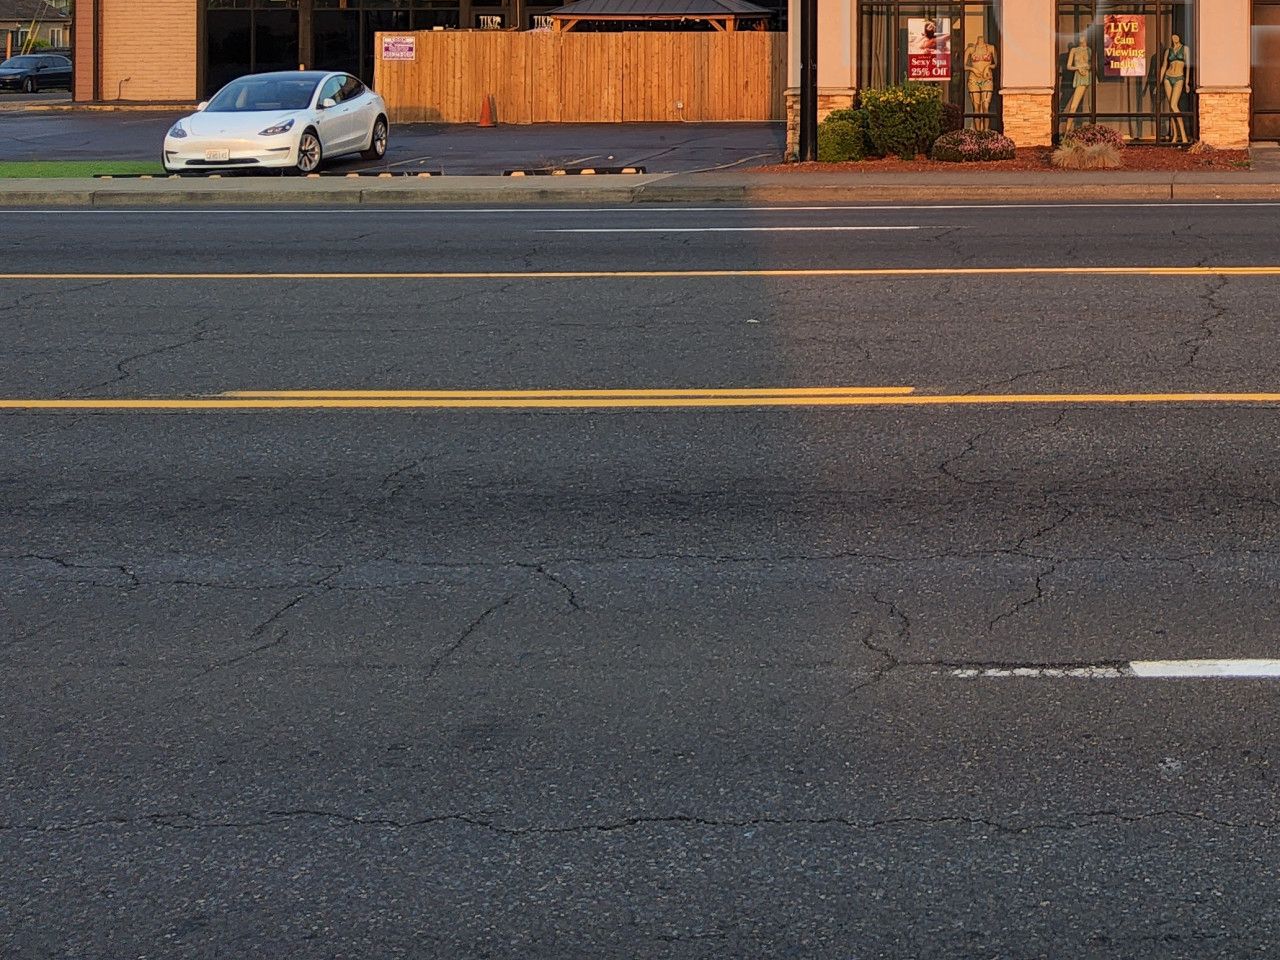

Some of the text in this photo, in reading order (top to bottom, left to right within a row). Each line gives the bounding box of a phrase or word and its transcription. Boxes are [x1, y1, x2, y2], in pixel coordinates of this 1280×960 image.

[1110, 22, 1139, 33] LIVE
[1113, 35, 1135, 45] Cam
[1105, 48, 1145, 58] Viewing
[911, 58, 947, 68] Sexy Spa
[911, 67, 948, 76] 25% Off
